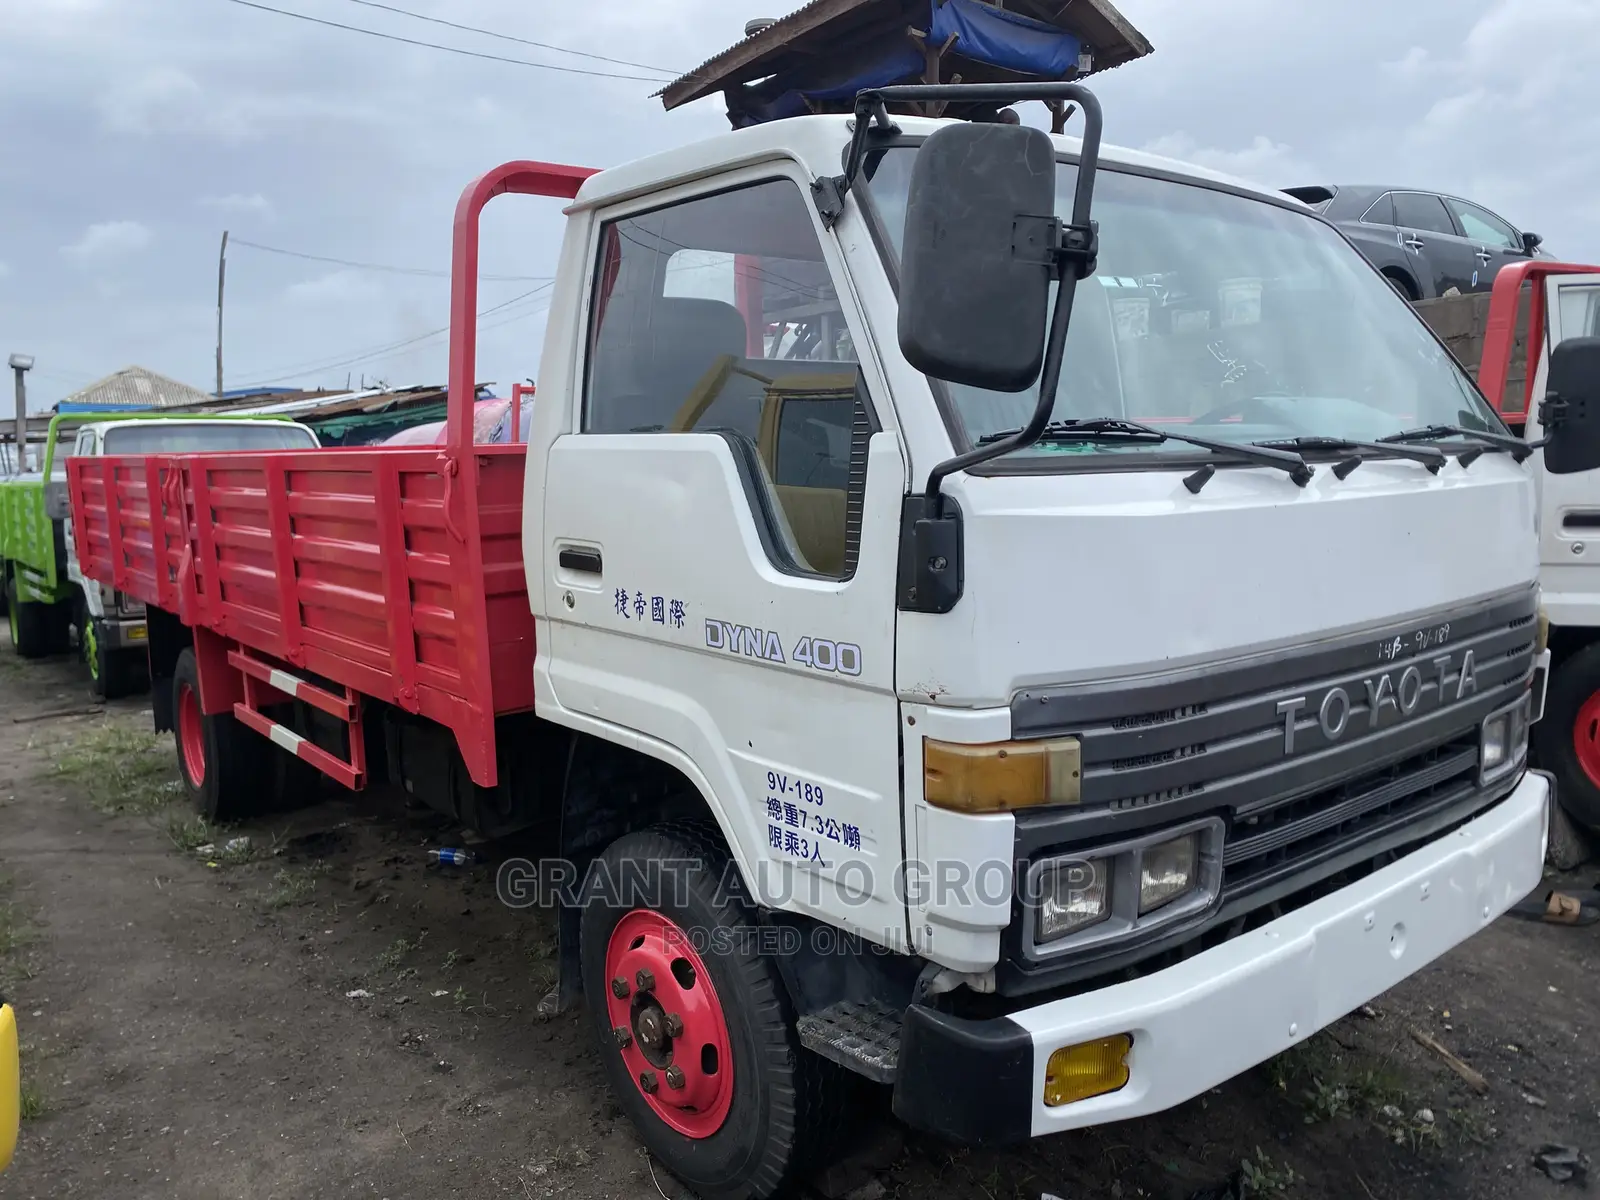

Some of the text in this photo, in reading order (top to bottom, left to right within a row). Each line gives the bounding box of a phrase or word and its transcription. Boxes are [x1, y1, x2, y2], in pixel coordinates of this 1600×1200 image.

[614, 587, 687, 629] 捷帝國際
[705, 618, 862, 676] DYNA 400
[1276, 649, 1477, 754] TOYOTA
[767, 771, 824, 806] 9V-189
[767, 823, 826, 868] 限乘3人
